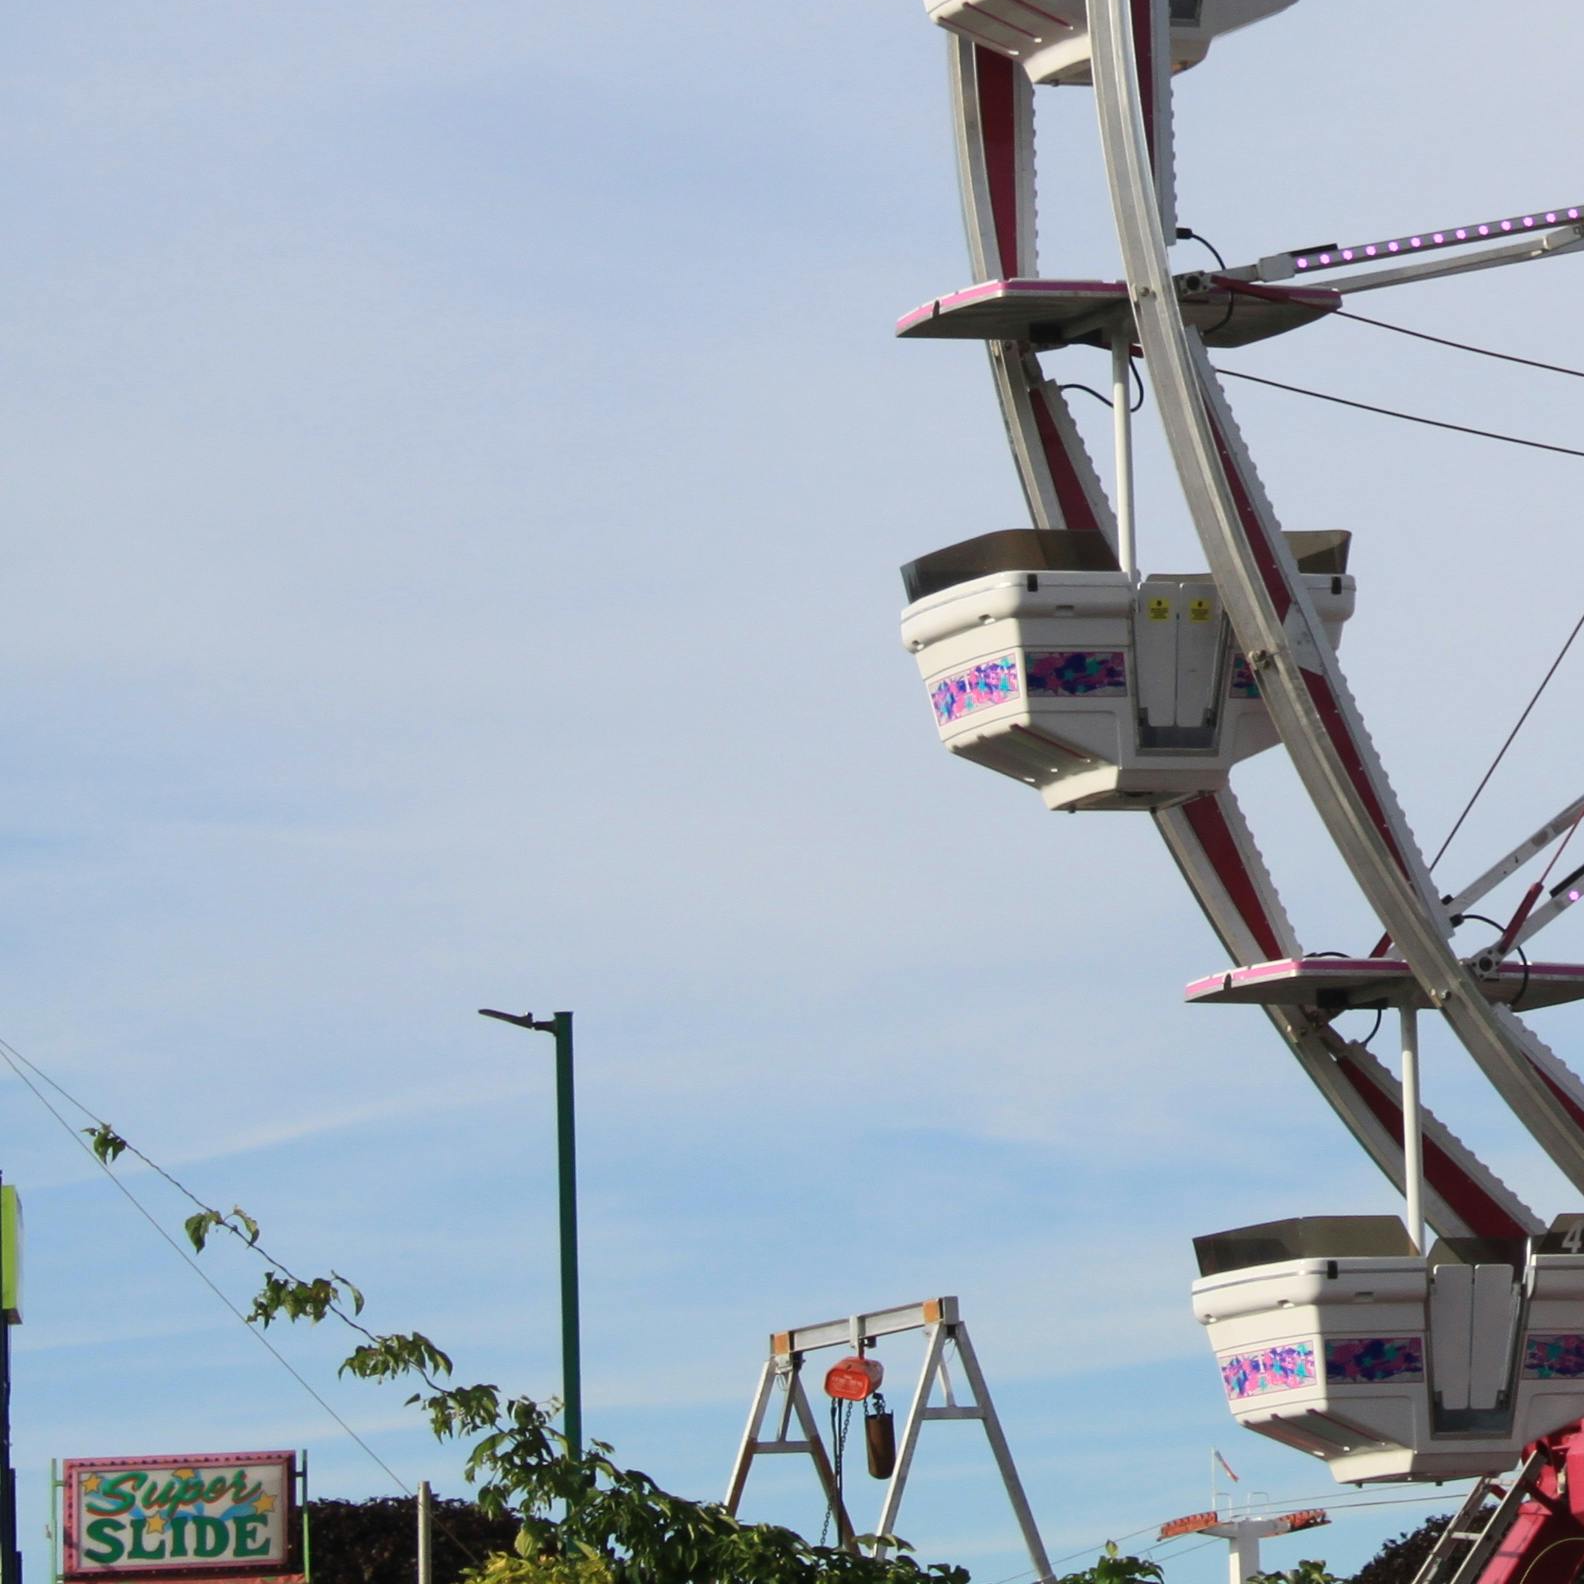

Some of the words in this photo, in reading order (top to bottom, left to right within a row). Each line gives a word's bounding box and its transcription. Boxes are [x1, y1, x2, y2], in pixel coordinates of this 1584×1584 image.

[1562, 1222, 1583, 1253] 4
[84, 1469, 263, 1519] Super
[84, 1515, 271, 1564] SLIDE
